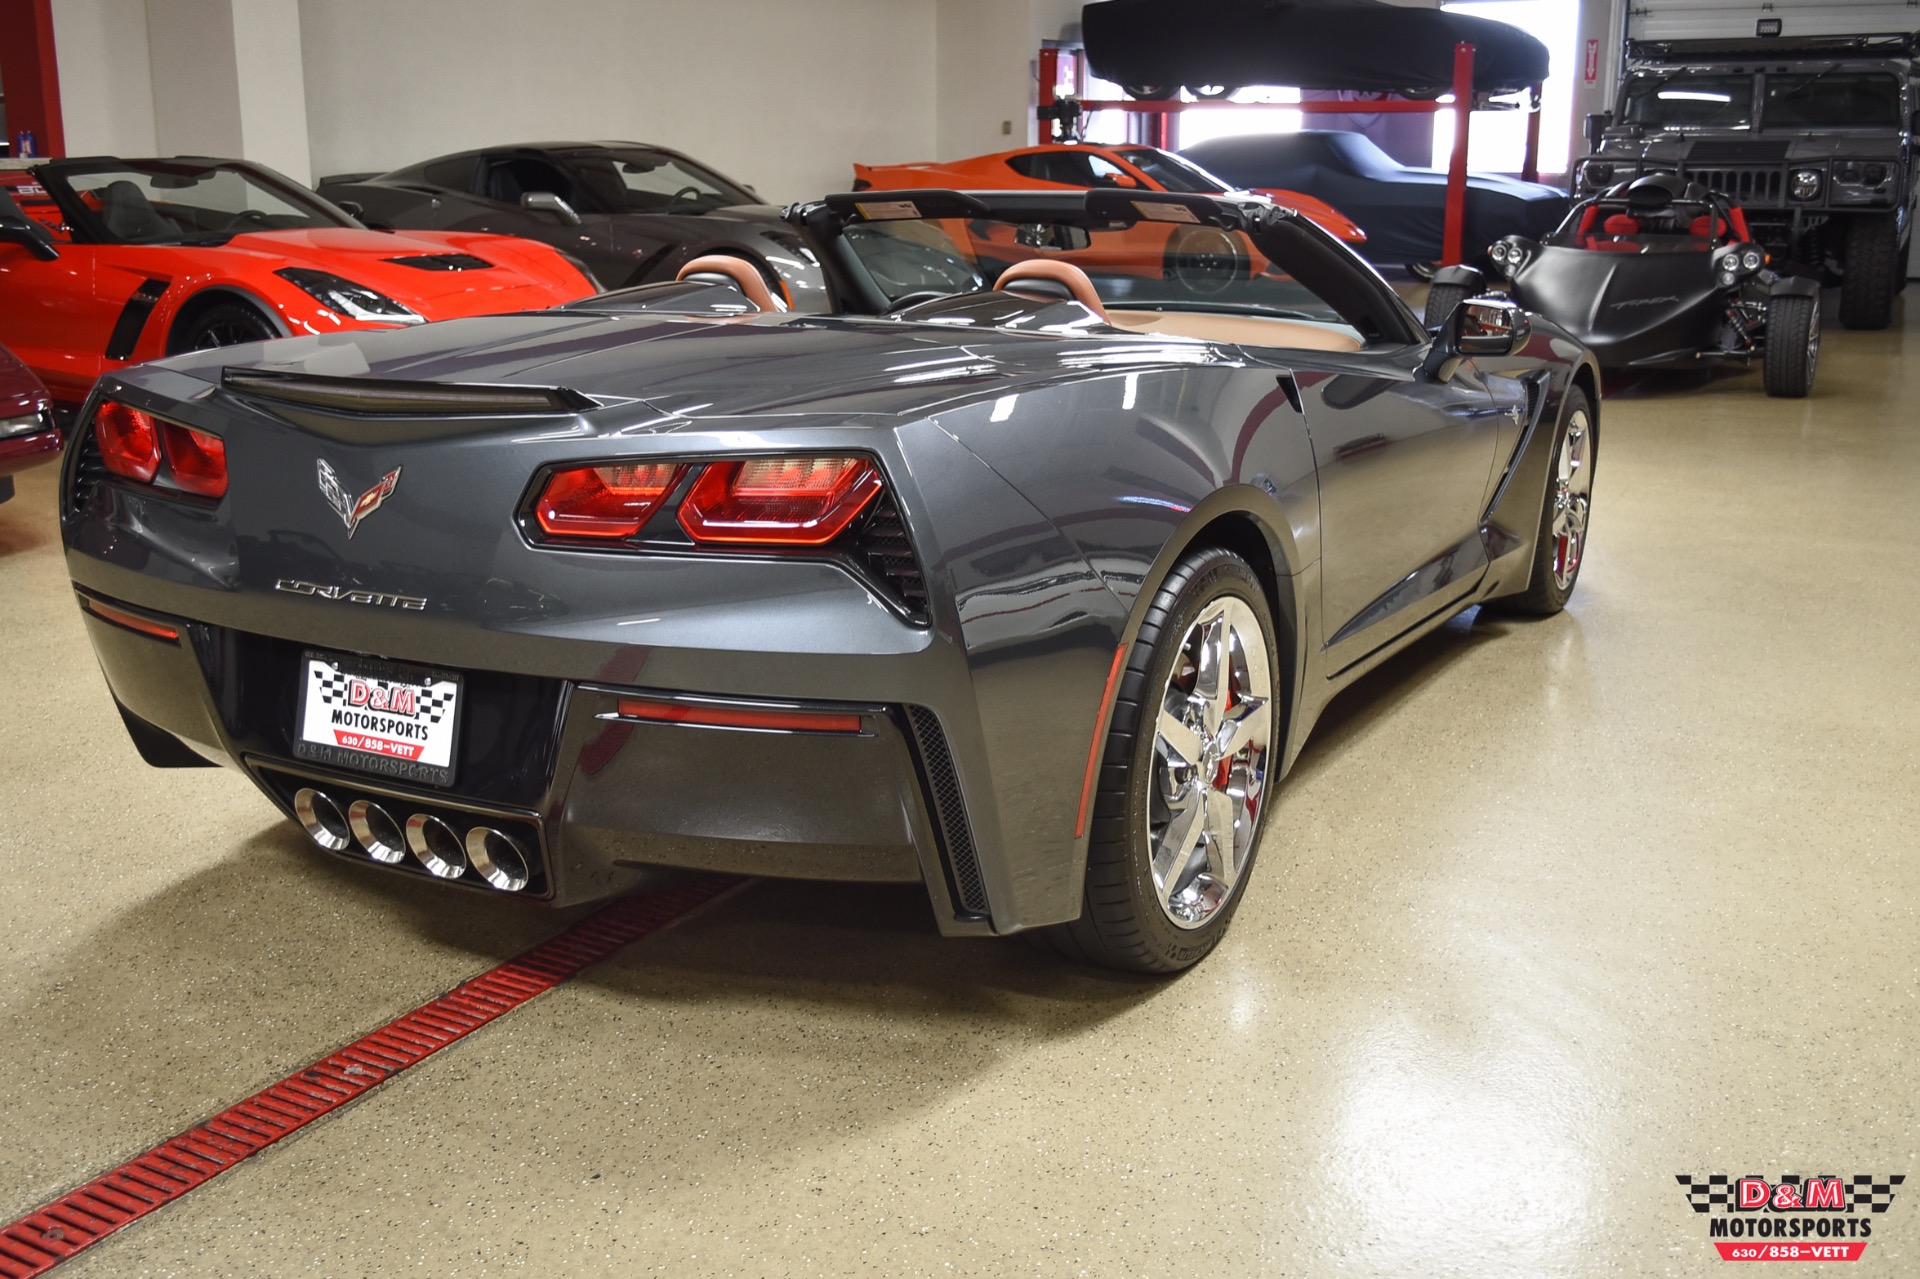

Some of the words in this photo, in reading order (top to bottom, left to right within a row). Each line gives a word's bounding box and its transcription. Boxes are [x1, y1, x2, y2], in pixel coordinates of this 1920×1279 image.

[275, 578, 428, 611] CORVETTE
[349, 679, 416, 717] D&M
[331, 709, 429, 741] MOTORSPORTS
[341, 735, 415, 757] 630/858-VETT
[337, 750, 449, 784] MOTORSPORTS
